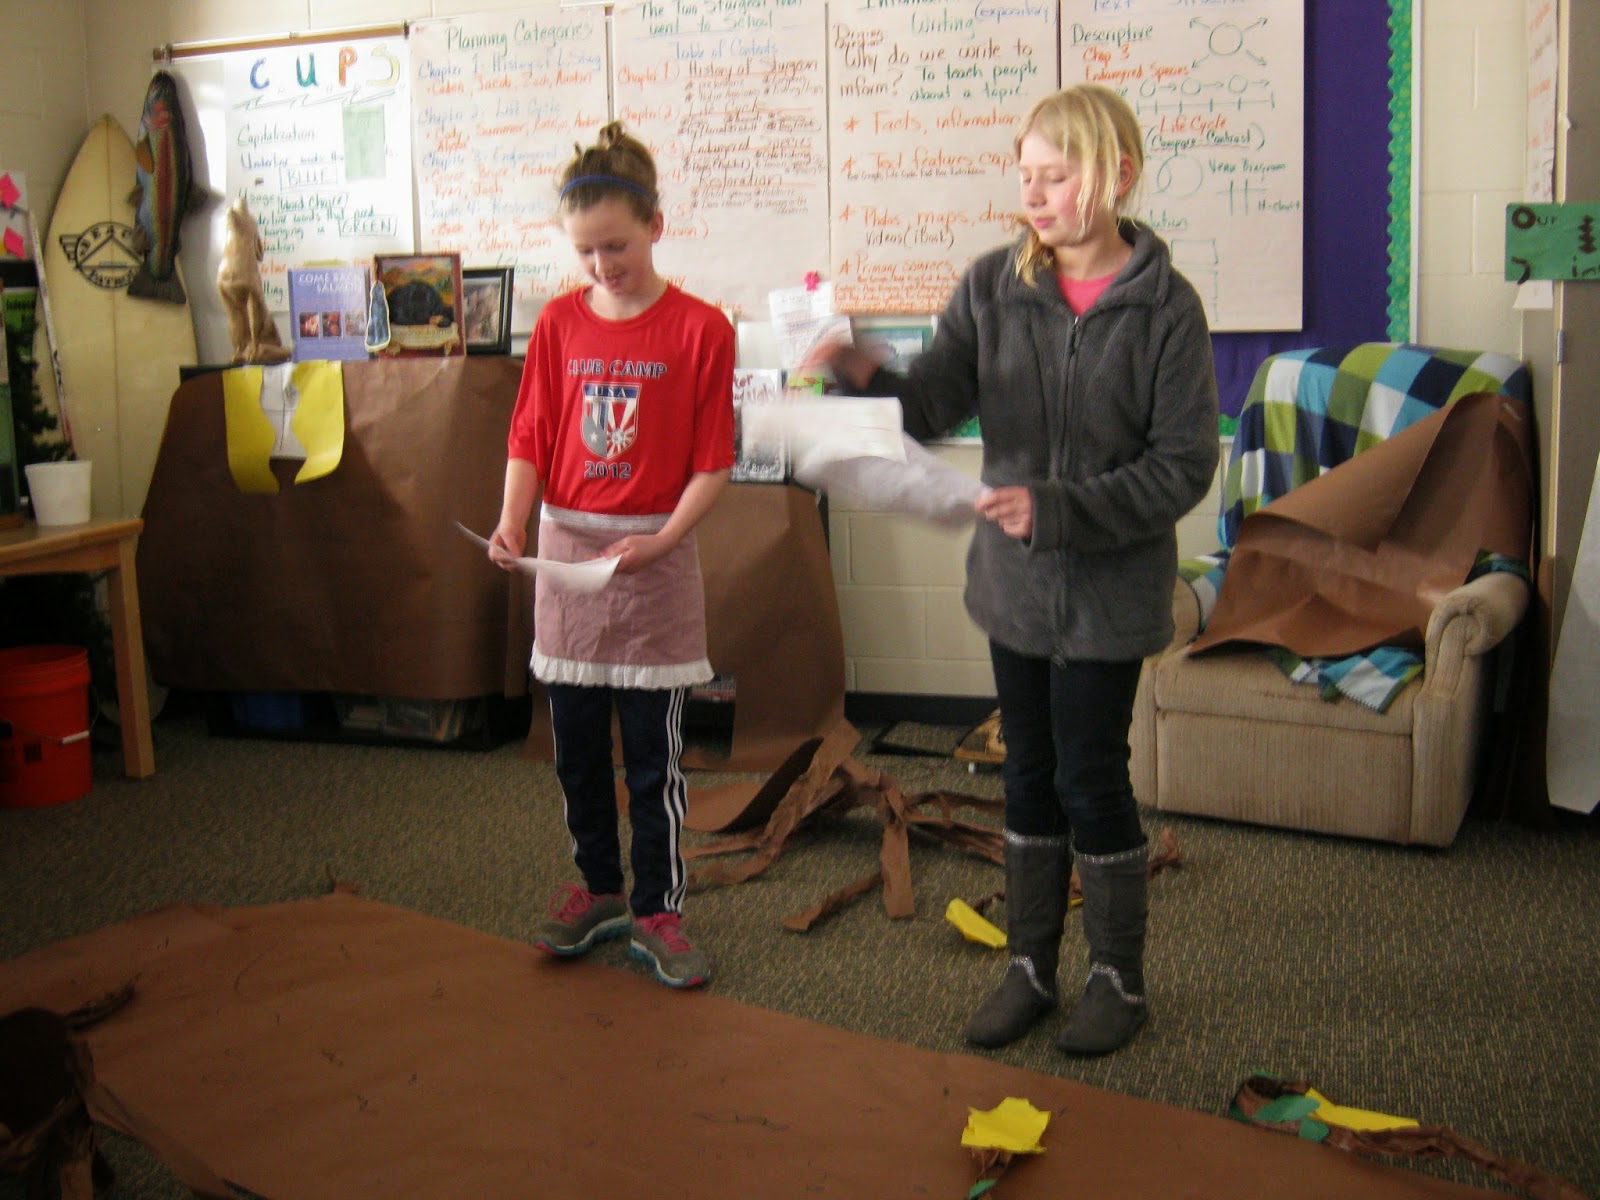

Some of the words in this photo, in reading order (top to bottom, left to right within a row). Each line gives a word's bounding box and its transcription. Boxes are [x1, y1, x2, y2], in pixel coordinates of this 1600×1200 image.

[911, 9, 977, 40] Writing
[1070, 20, 1153, 47] Descriptive
[444, 26, 508, 56] Planning
[514, 19, 593, 48] Categories
[888, 42, 910, 64] do
[919, 48, 946, 61] we
[958, 37, 1001, 61] write
[1015, 37, 1033, 56] to
[418, 59, 463, 84] Chapter
[944, 63, 983, 81] teach
[992, 60, 1038, 83] people
[298, 271, 329, 285] COME
[610, 359, 668, 378] CAMP
[594, 385, 627, 397] USA
[584, 460, 632, 479] 2012
